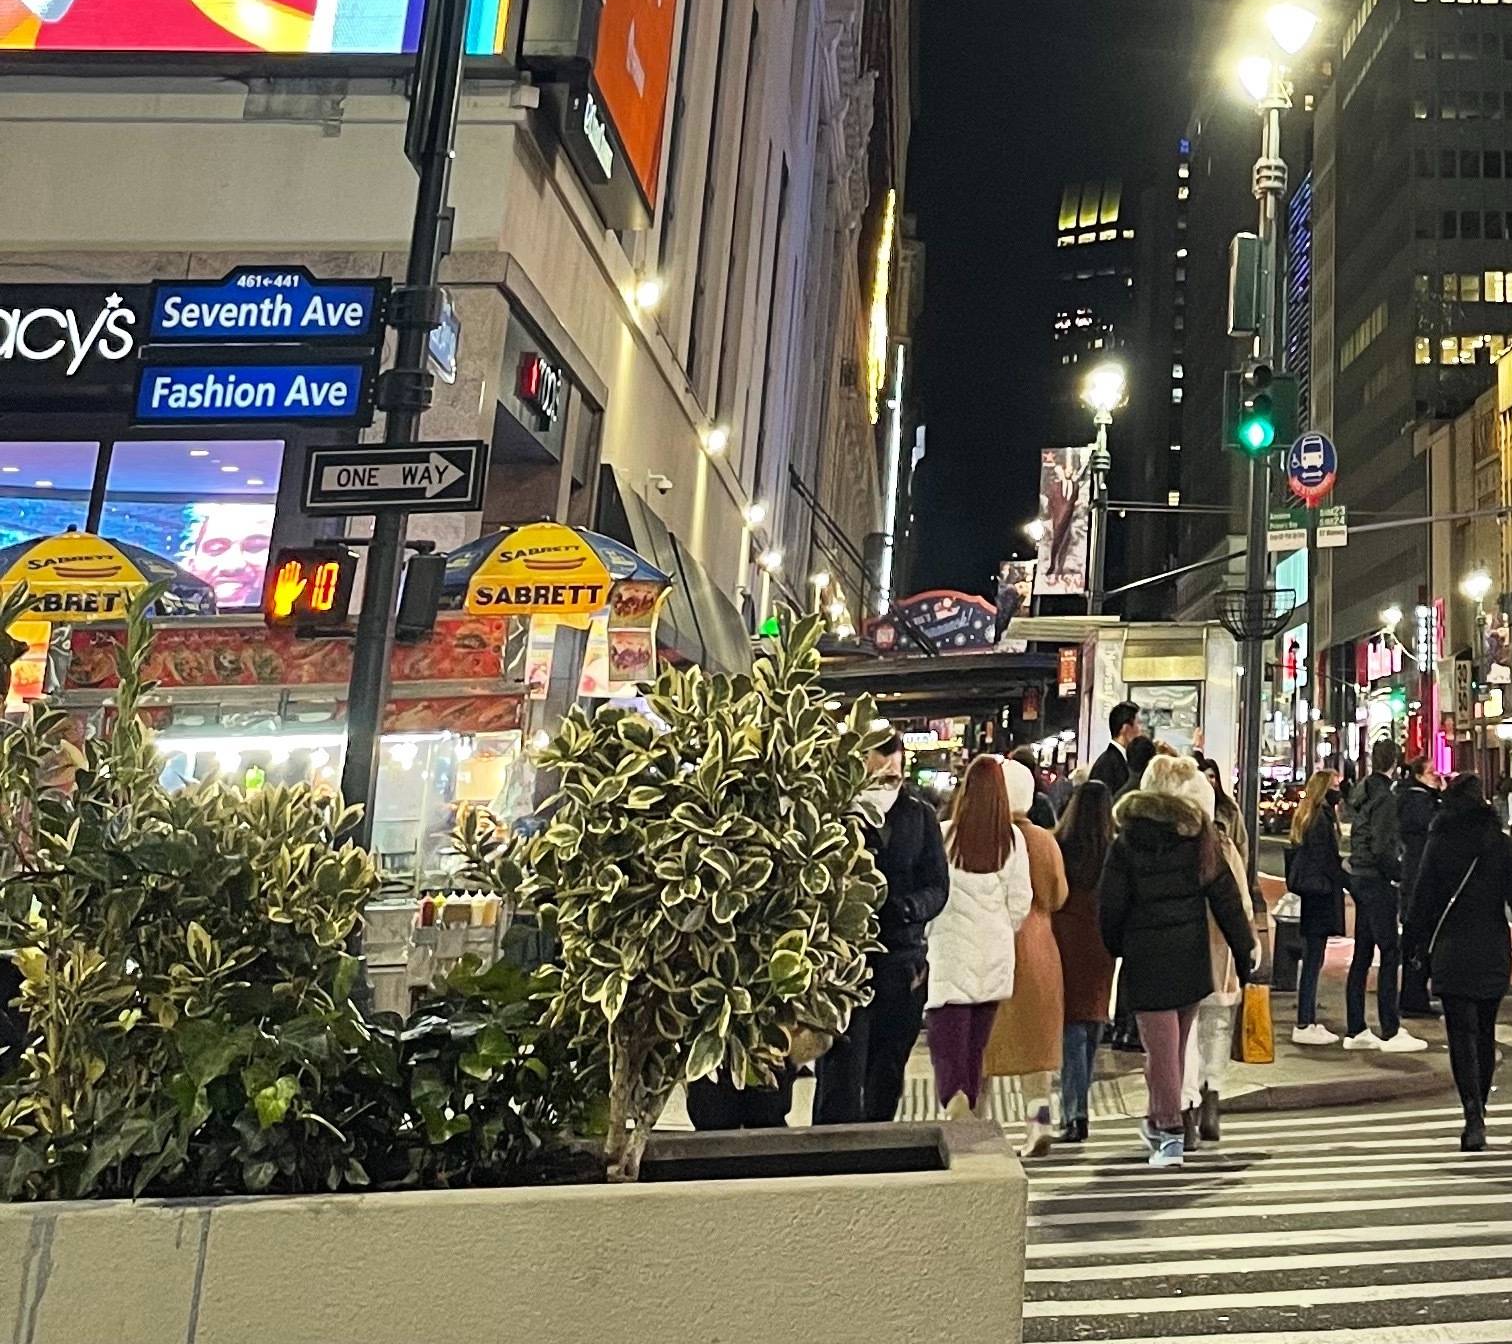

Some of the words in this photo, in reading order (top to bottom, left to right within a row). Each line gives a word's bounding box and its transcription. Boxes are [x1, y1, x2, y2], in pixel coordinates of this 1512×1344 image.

[237, 275, 262, 288] 461
[274, 274, 299, 287] 441
[162, 294, 292, 328] Seventh
[301, 296, 363, 326] Ave
[151, 374, 276, 408] Fashion
[284, 375, 348, 406] Ave
[337, 467, 380, 487] ONE
[402, 465, 449, 485] WAY
[499, 545, 580, 562] SABRETT
[311, 562, 340, 611] 10
[476, 585, 603, 606] SABRETT
[30, 588, 133, 613] BRET
